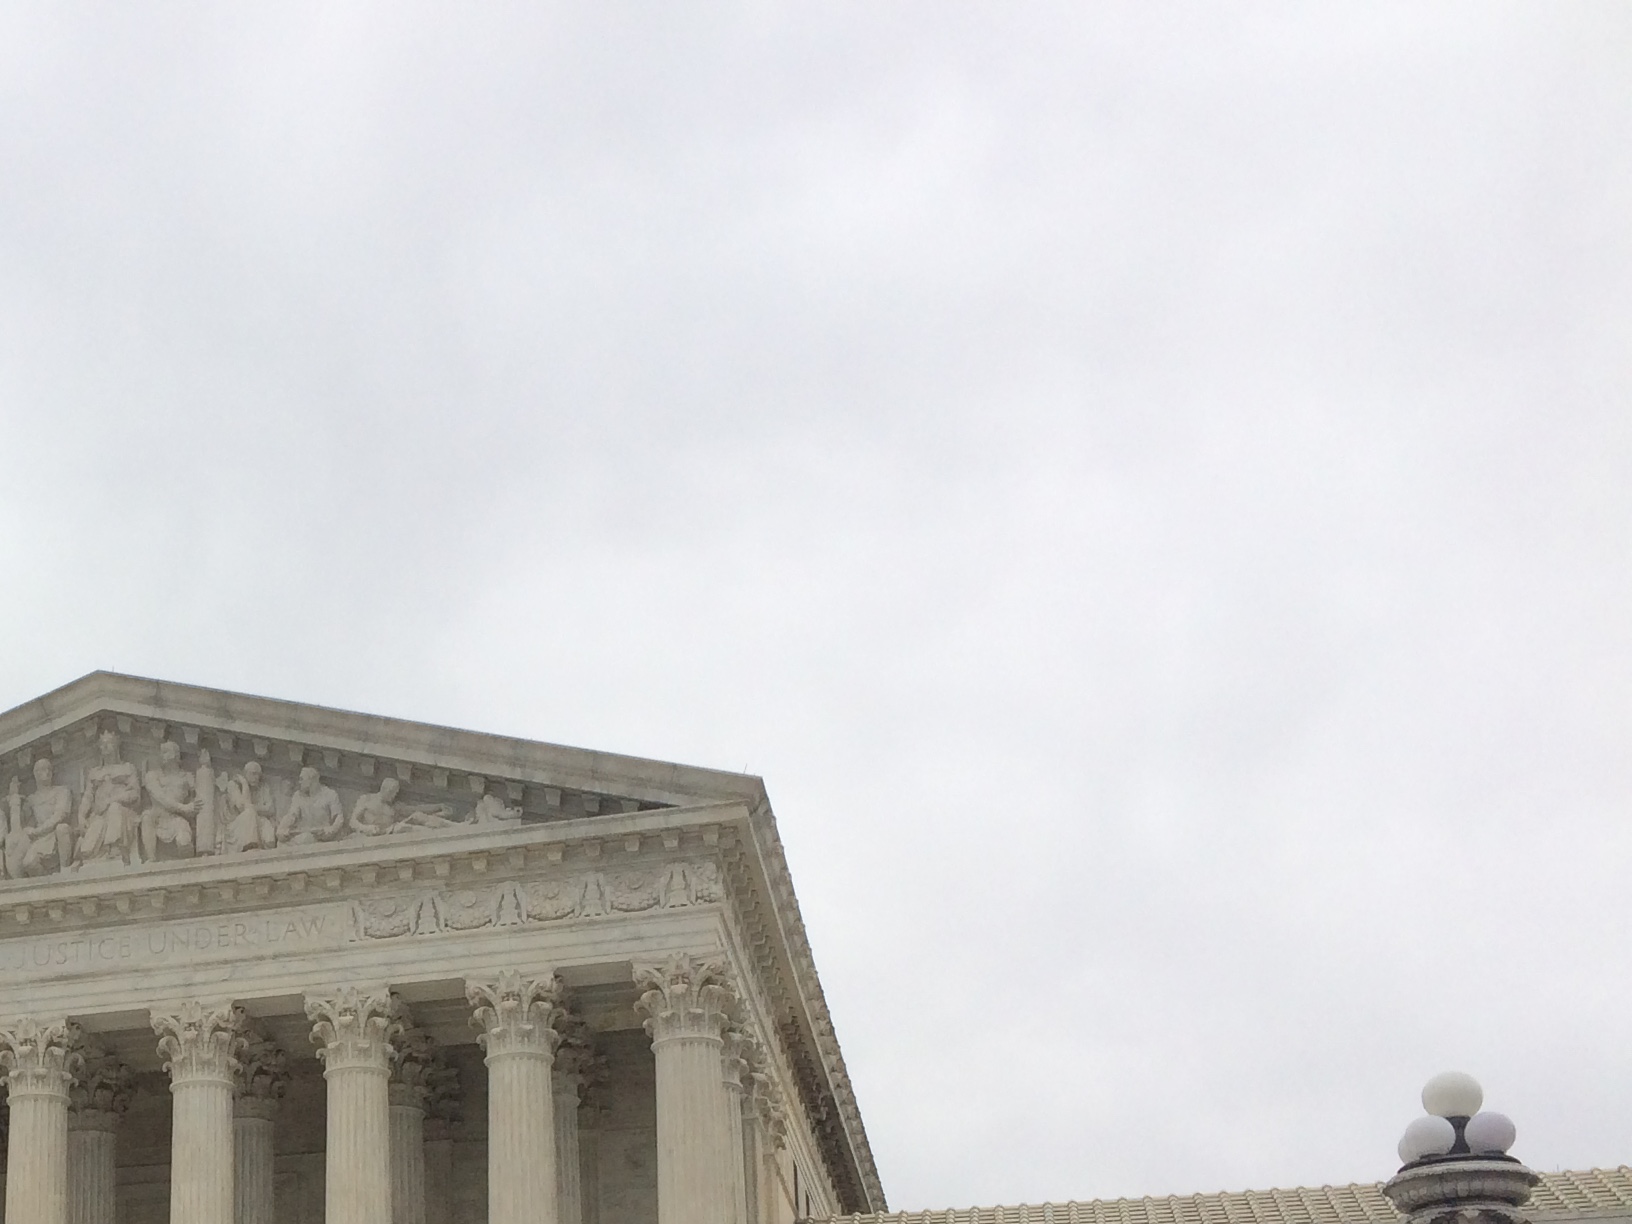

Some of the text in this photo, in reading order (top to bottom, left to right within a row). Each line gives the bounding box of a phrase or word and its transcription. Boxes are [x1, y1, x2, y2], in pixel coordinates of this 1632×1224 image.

[13, 935, 132, 970] JUSTICE
[148, 923, 256, 954] UNDER
[266, 914, 327, 943] LAW
